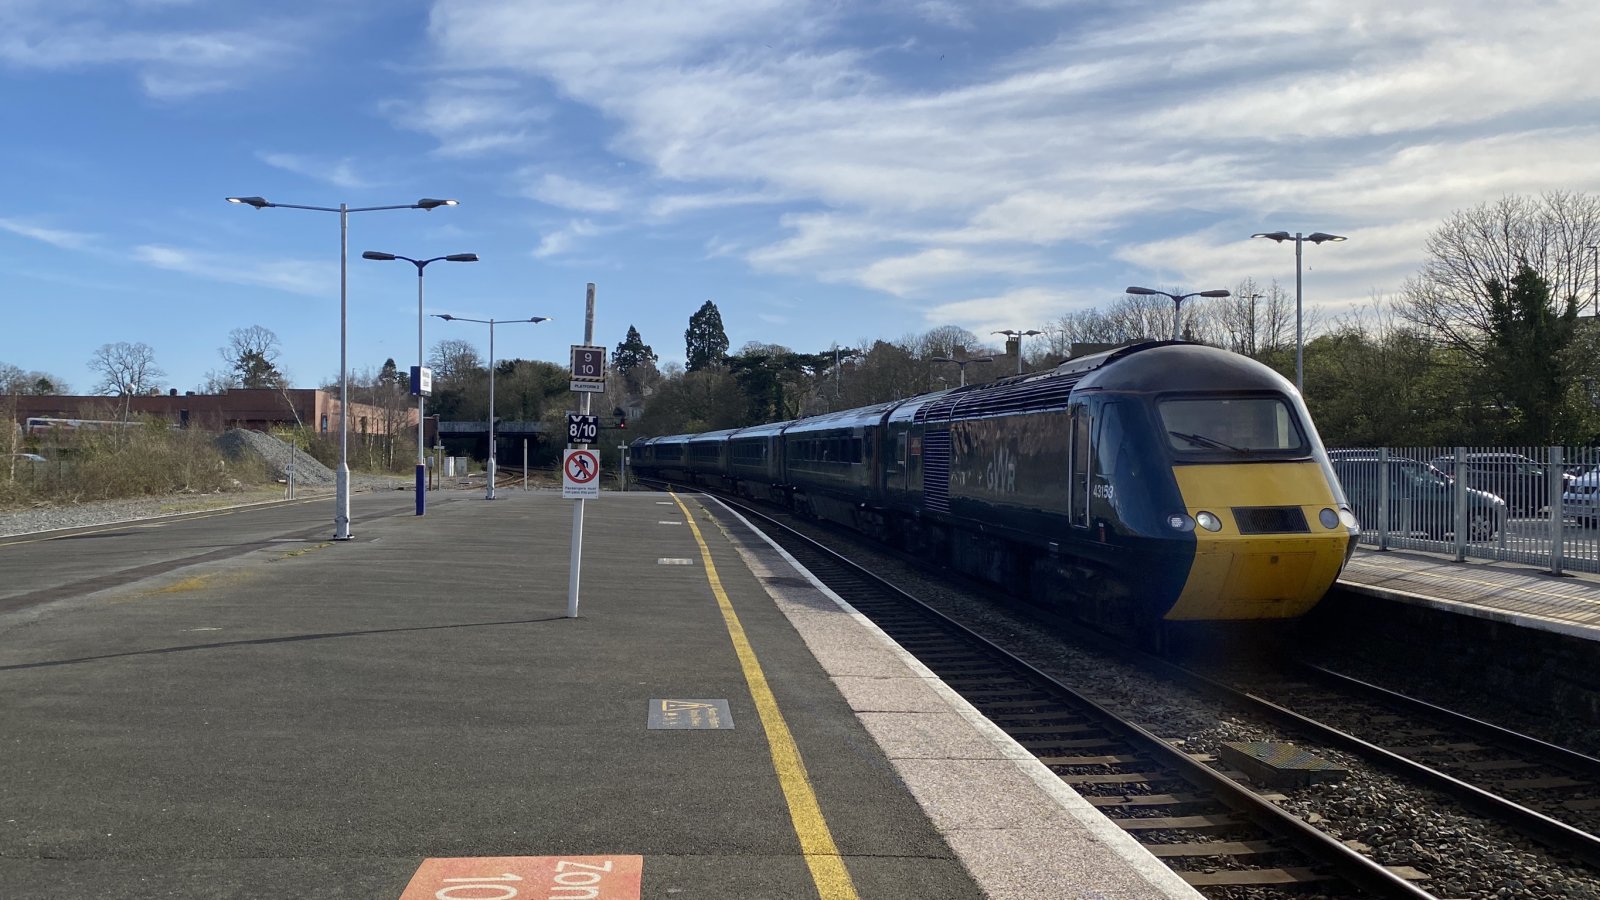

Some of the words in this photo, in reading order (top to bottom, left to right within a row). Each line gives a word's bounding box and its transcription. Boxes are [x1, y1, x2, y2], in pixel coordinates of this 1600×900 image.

[584, 352, 592, 363] 9
[582, 364, 594, 374] 10
[571, 415, 597, 423] VT
[569, 422, 597, 438] 8/10
[987, 446, 1016, 496] GWR
[1093, 484, 1114, 499] 43153
[435, 873, 523, 900] 10
